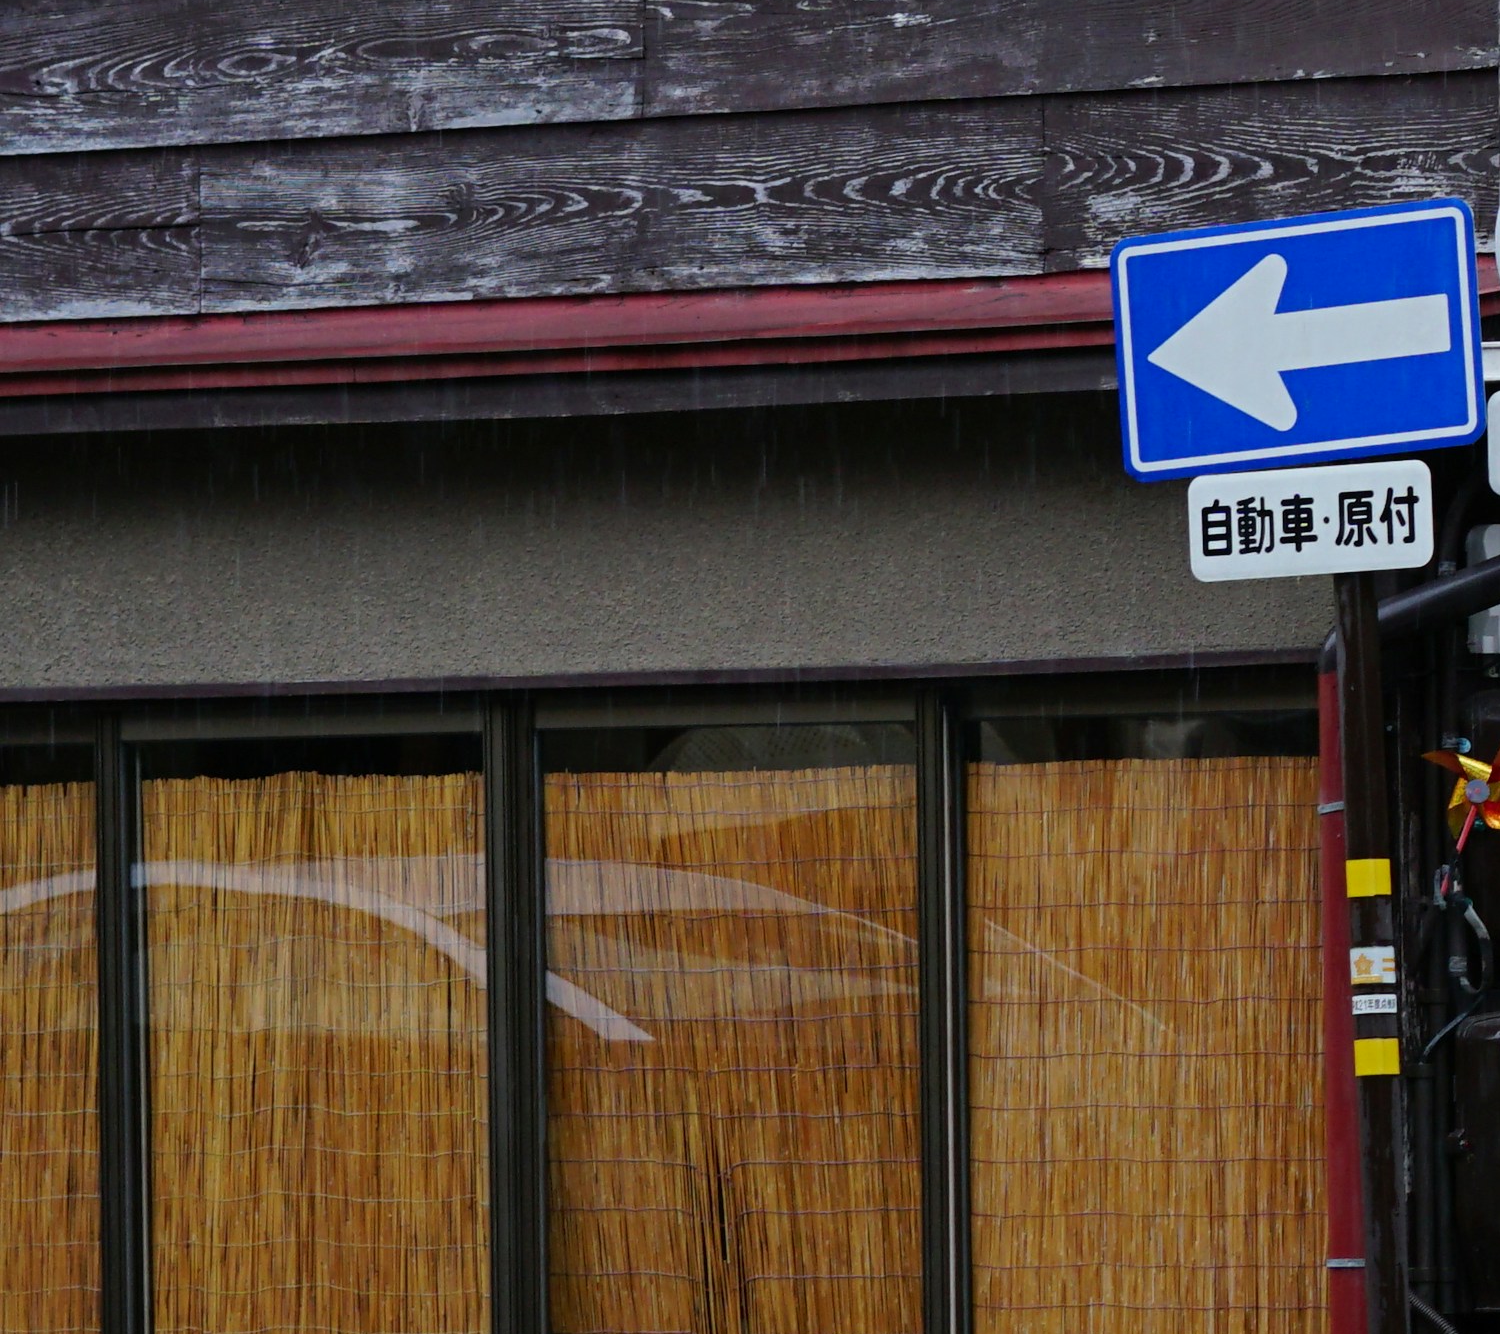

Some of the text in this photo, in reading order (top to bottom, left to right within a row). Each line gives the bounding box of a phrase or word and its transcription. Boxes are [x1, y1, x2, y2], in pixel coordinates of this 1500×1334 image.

[1201, 486, 1420, 557] 自動車・原付
